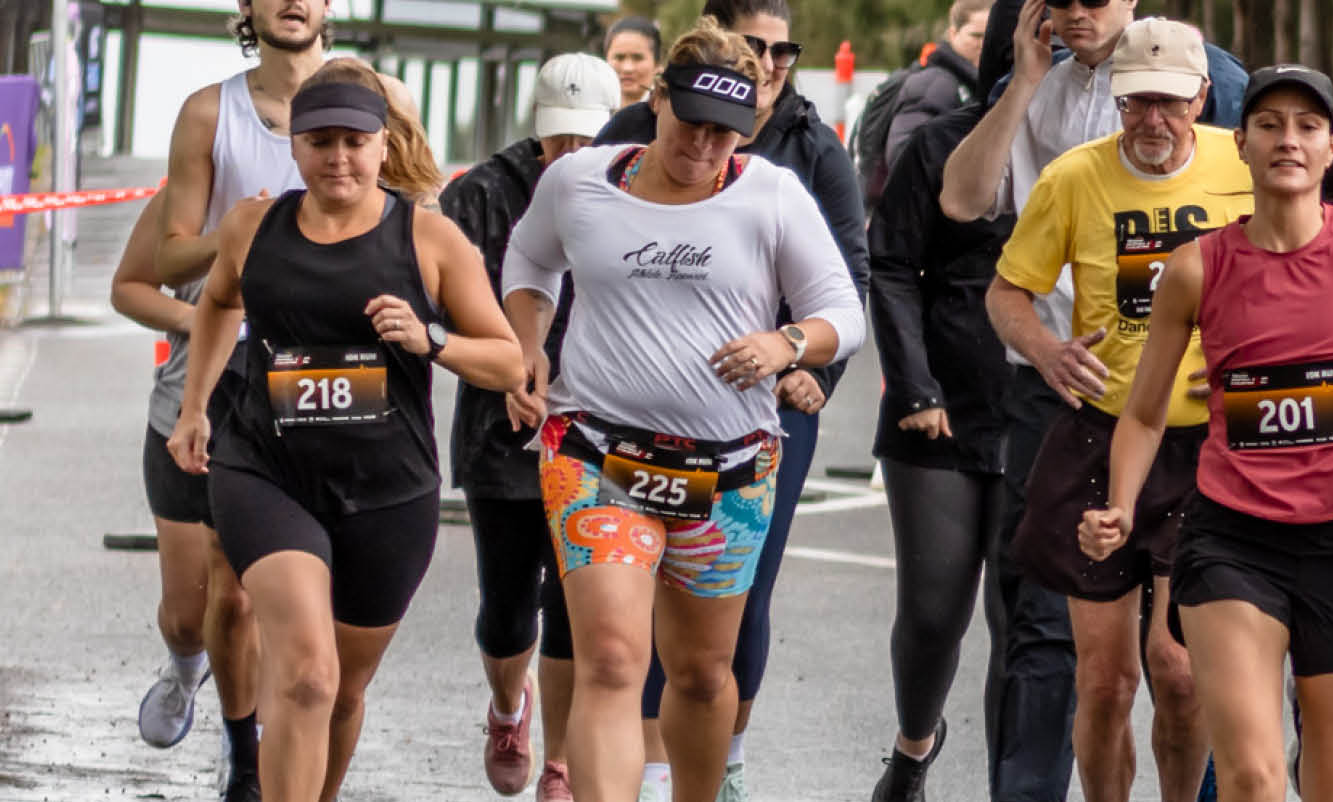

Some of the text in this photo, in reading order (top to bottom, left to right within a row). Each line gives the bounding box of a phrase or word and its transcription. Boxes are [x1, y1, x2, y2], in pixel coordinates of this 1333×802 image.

[297, 377, 353, 410] 218
[1257, 396, 1315, 433] 201
[629, 469, 688, 505] 225
